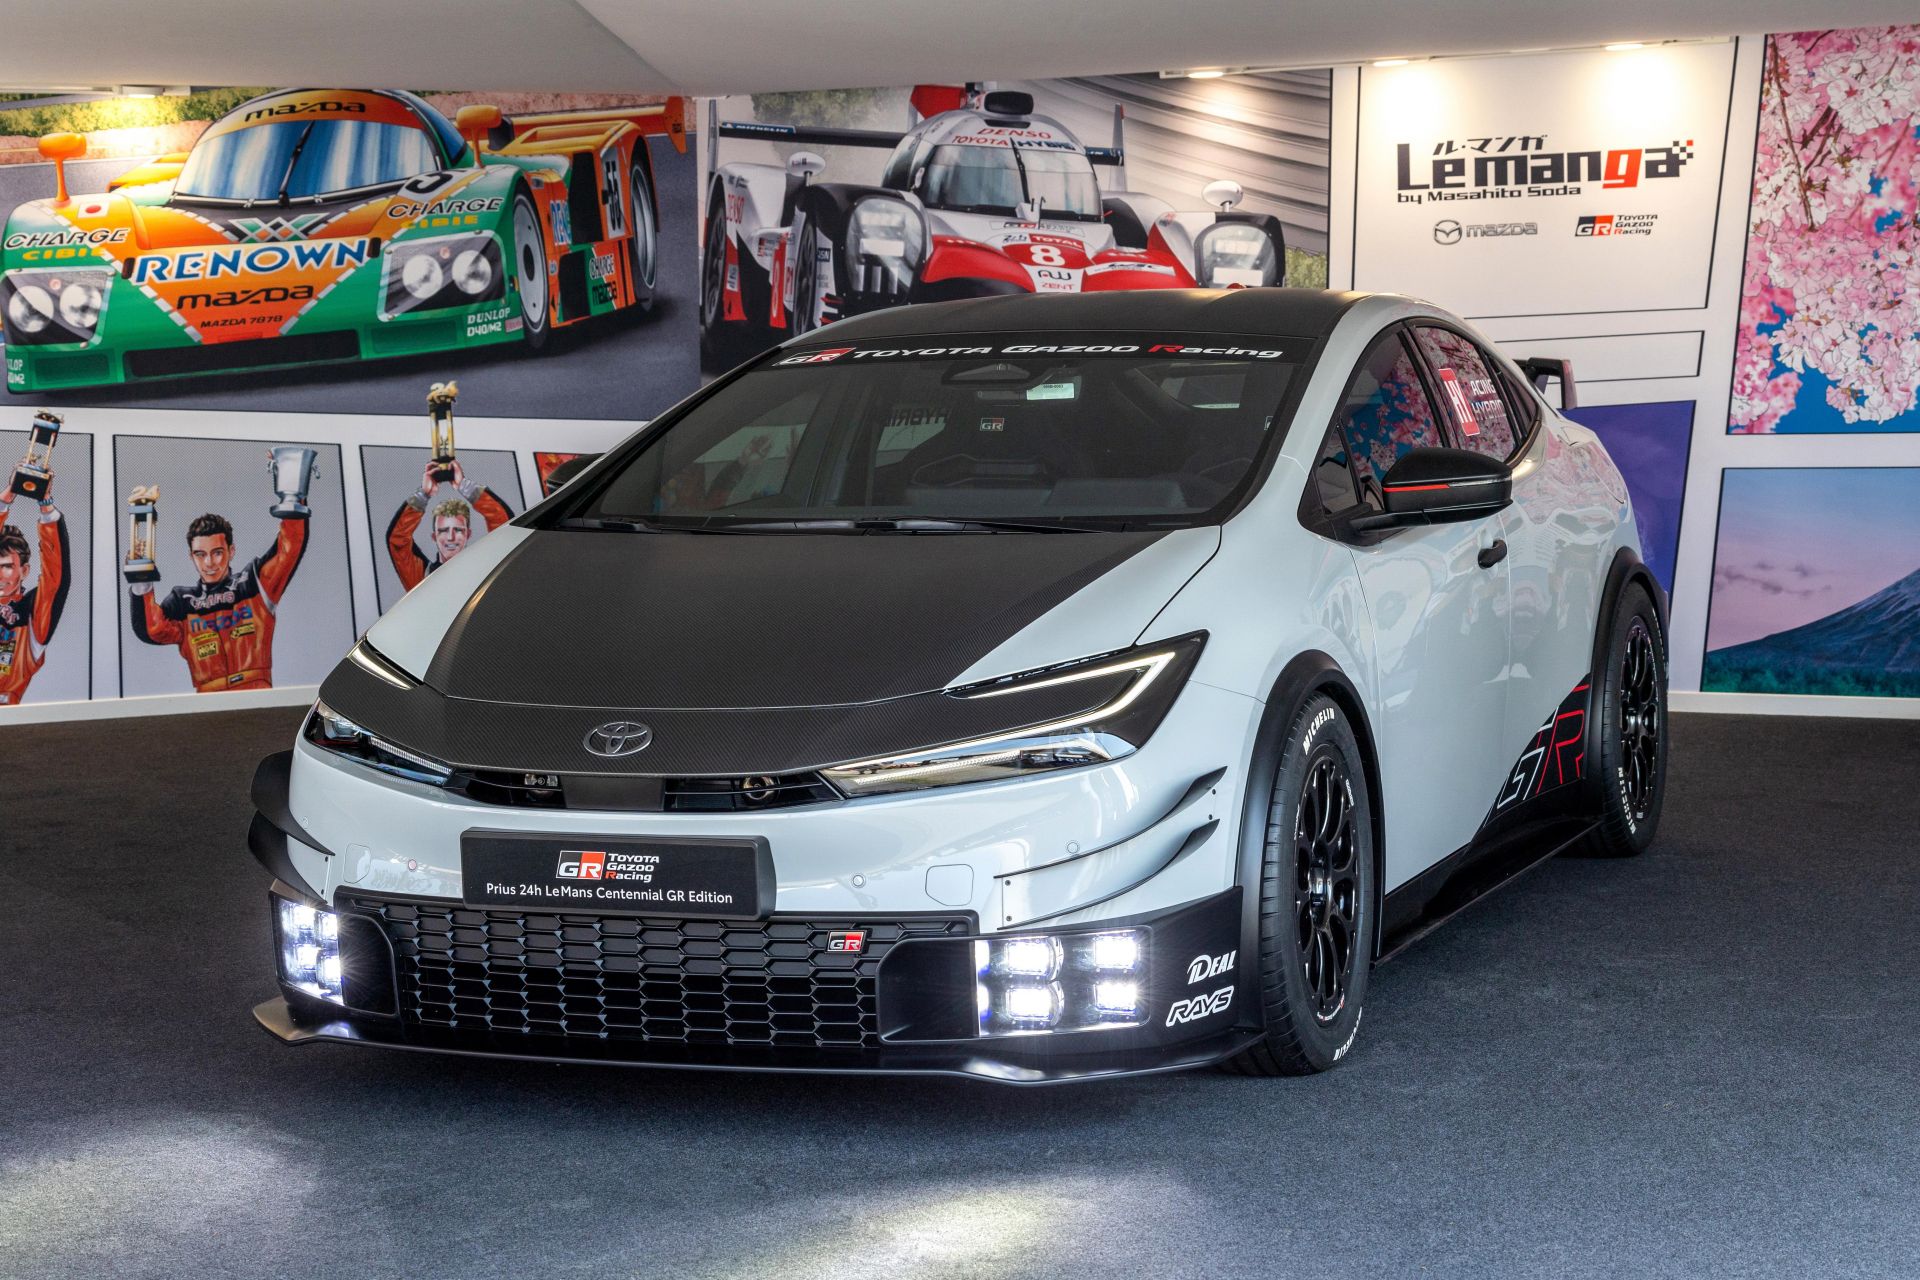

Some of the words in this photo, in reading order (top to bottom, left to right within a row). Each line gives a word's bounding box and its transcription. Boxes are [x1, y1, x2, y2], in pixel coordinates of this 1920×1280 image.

[244, 101, 366, 122] mazda
[951, 135, 1010, 147] TOYOTA
[976, 127, 1052, 139] DENSO
[1397, 192, 1422, 205] by
[1428, 188, 1522, 202] Masahito
[1527, 185, 1582, 198] Soda
[387, 198, 505, 218] CHARGE
[1466, 222, 1538, 238] mazda
[1576, 223, 1611, 237] GR
[1614, 228, 1652, 236] Racing
[5, 228, 130, 249] CHARGE
[1031, 235, 1083, 249] TOTAL
[135, 239, 368, 284] RENOWN
[1029, 244, 1066, 267] 8
[176, 285, 314, 310] mazda
[201, 318, 247, 329] MAZDA
[467, 307, 511, 325] DUNLOP
[853, 347, 993, 359] TOYOTA
[1001, 345, 1140, 354] GAZOO
[1148, 345, 1284, 359] Racing
[981, 422, 1003, 430] GR
[1303, 707, 1335, 756] MICHELIN
[607, 853, 660, 864] TOYOTA
[558, 861, 602, 878] GR
[606, 862, 655, 872] GAZOO
[605, 870, 653, 883] Racing
[486, 882, 516, 895] Prius
[519, 883, 542, 896] 24h
[596, 886, 664, 902] Centennial
[666, 889, 686, 902] GR
[688, 890, 734, 905] Edition
[829, 939, 861, 950] GR
[1165, 985, 1235, 1028] RAYS
